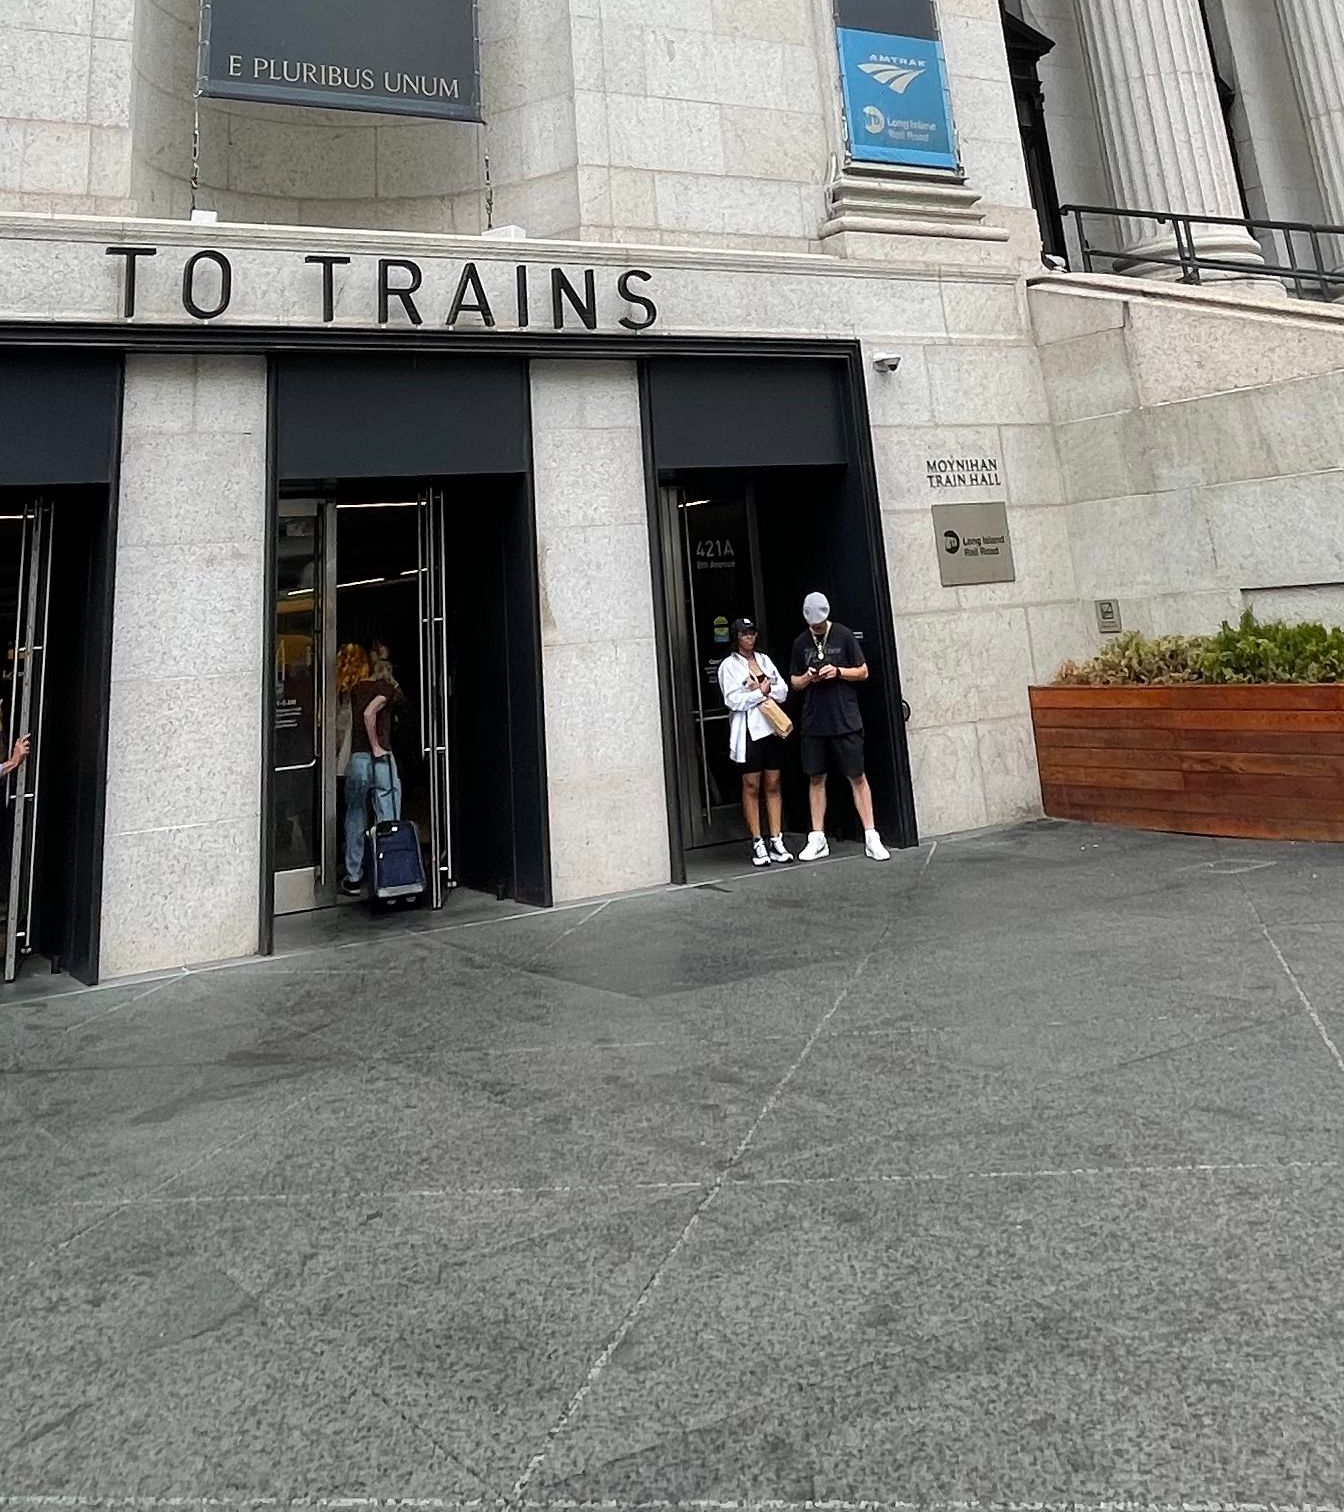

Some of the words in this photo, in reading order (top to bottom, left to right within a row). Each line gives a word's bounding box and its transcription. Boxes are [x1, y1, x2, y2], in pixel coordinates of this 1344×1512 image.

[869, 54, 926, 67] AMTRAK
[228, 55, 242, 77] E
[253, 57, 374, 91] PLURIBUS
[385, 73, 458, 98] UNUM
[106, 246, 232, 320] TO
[305, 254, 657, 330] TRAINS
[926, 459, 998, 473] MOYNIHAN
[927, 474, 966, 488] TRAIN
[970, 473, 1001, 486] HALL
[696, 539, 735, 557] 421A
